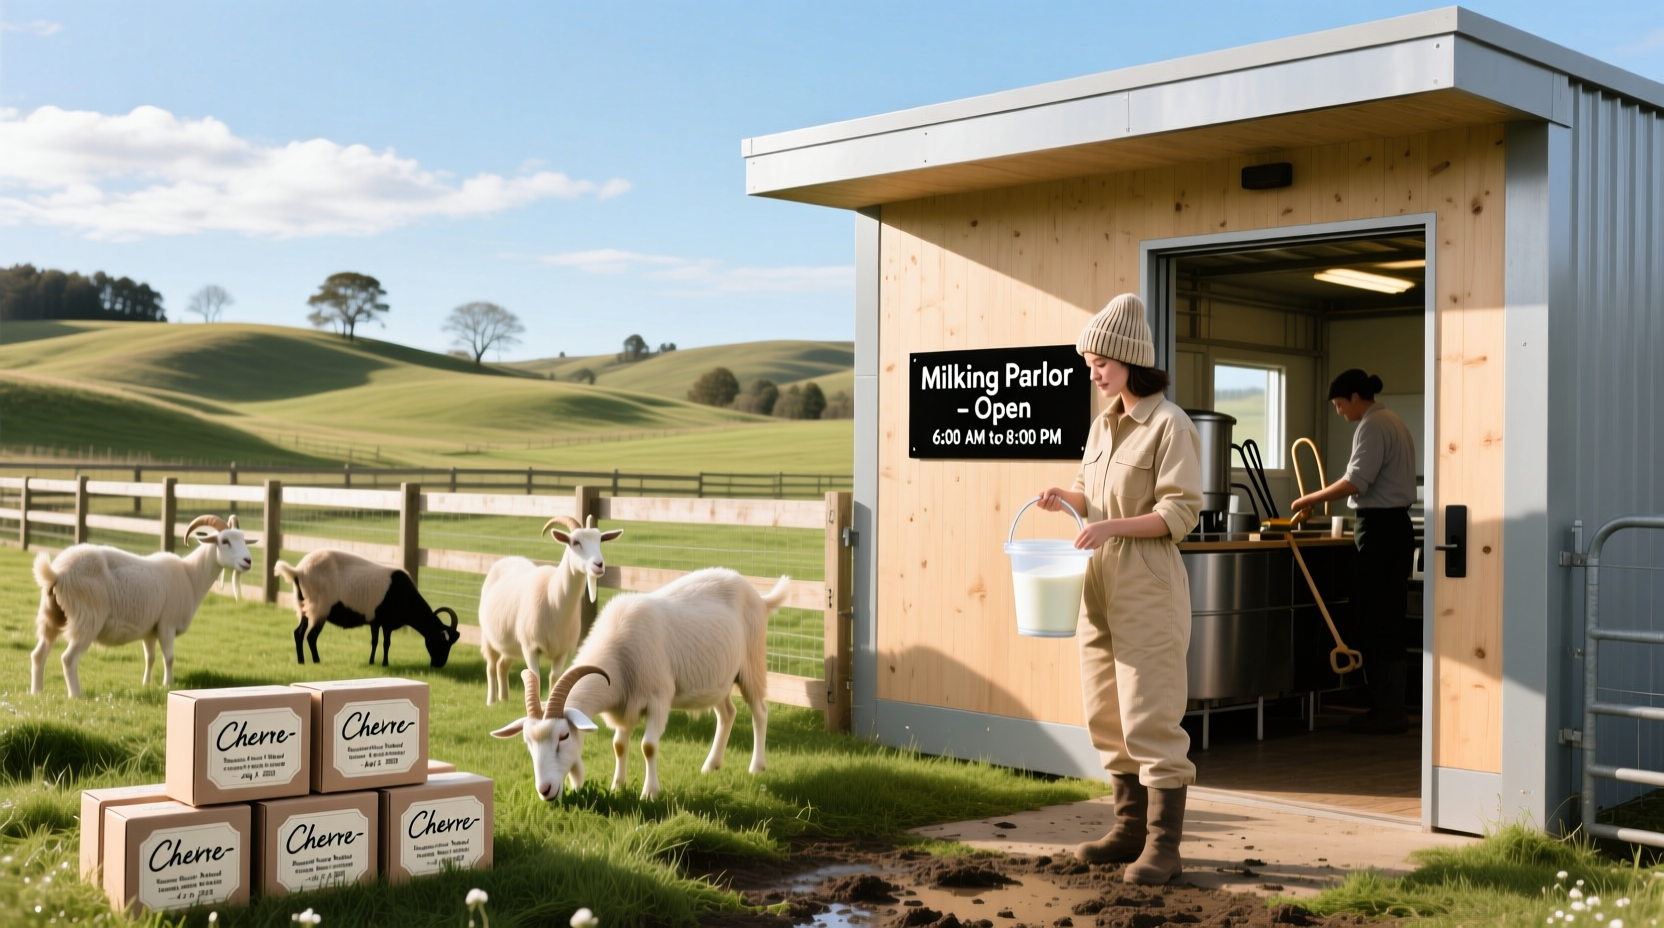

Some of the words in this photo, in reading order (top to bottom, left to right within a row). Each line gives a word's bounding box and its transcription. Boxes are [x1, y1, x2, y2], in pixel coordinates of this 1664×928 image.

[921, 364, 999, 396] Milking
[1005, 360, 1074, 388] Parlor
[974, 395, 1031, 426] Open
[932, 428, 961, 446] 6:00
[964, 428, 986, 445] AM
[988, 430, 1004, 445] to
[1005, 428, 1037, 445] 8:00
[1039, 427, 1062, 445] PM
